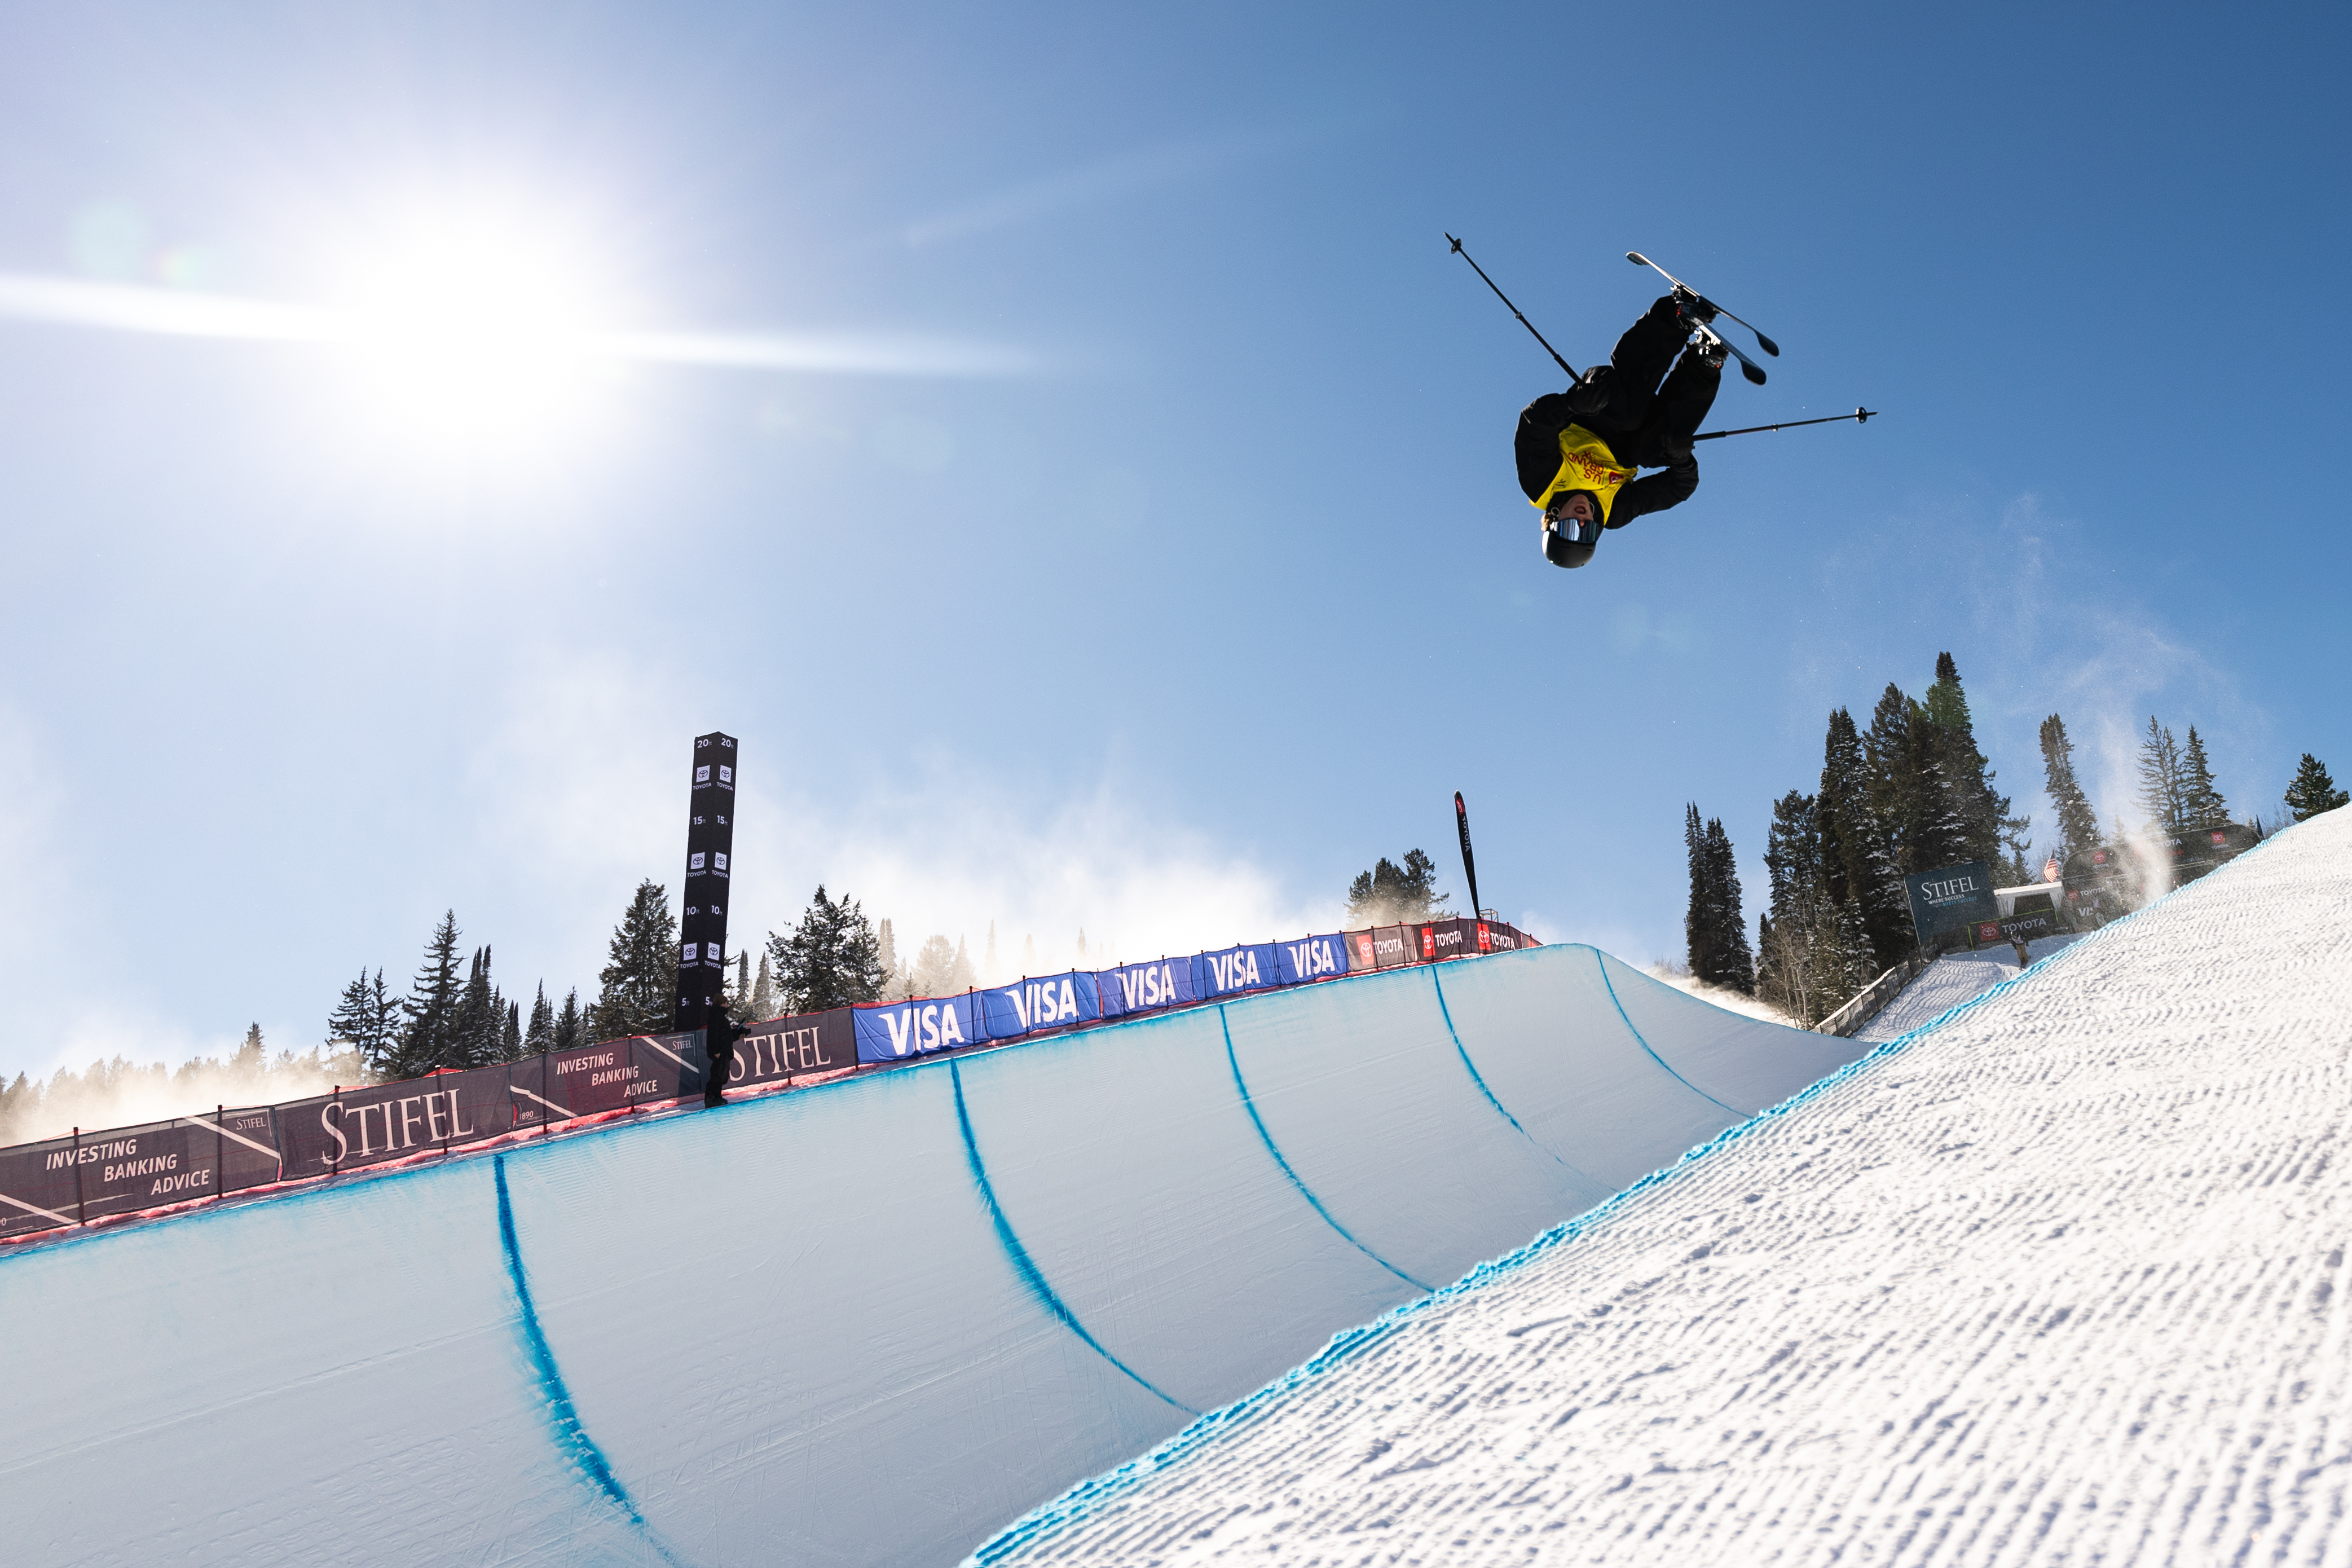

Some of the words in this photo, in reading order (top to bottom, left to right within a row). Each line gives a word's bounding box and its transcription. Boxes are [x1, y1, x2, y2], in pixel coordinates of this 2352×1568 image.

[716, 782, 733, 791] TOYOTA
[1462, 816, 1470, 852] TOYOTA
[2152, 838, 2182, 848] OYOTA
[712, 870, 728, 878] TOYOTA
[1921, 876, 1979, 900] STIFEL
[2080, 887, 2106, 896] TOYOTA
[2002, 918, 2047, 933] TOYOTA
[1373, 938, 1403, 955] TOYOTA
[1435, 931, 1463, 947] TOYOTA
[1490, 932, 1516, 950] TOYOTA
[704, 961, 721, 970] TOYOTA
[1288, 940, 1336, 978] VISA
[1208, 950, 1261, 991] VISA
[1115, 964, 1177, 1010] VISA
[1005, 979, 1080, 1028] VISA
[878, 1003, 965, 1056] VISA
[672, 1040, 693, 1051] STIFEL
[557, 1052, 614, 1075] INVESTING
[592, 1065, 638, 1086] BANKING
[623, 1080, 658, 1098] ADVICE
[236, 1116, 266, 1131] STIFEL
[519, 1110, 534, 1120] 1890
[320, 1089, 474, 1165] STIFEL
[46, 1138, 137, 1170] INVESTING
[104, 1153, 178, 1182] BANKING
[151, 1169, 210, 1195] ADVICE
